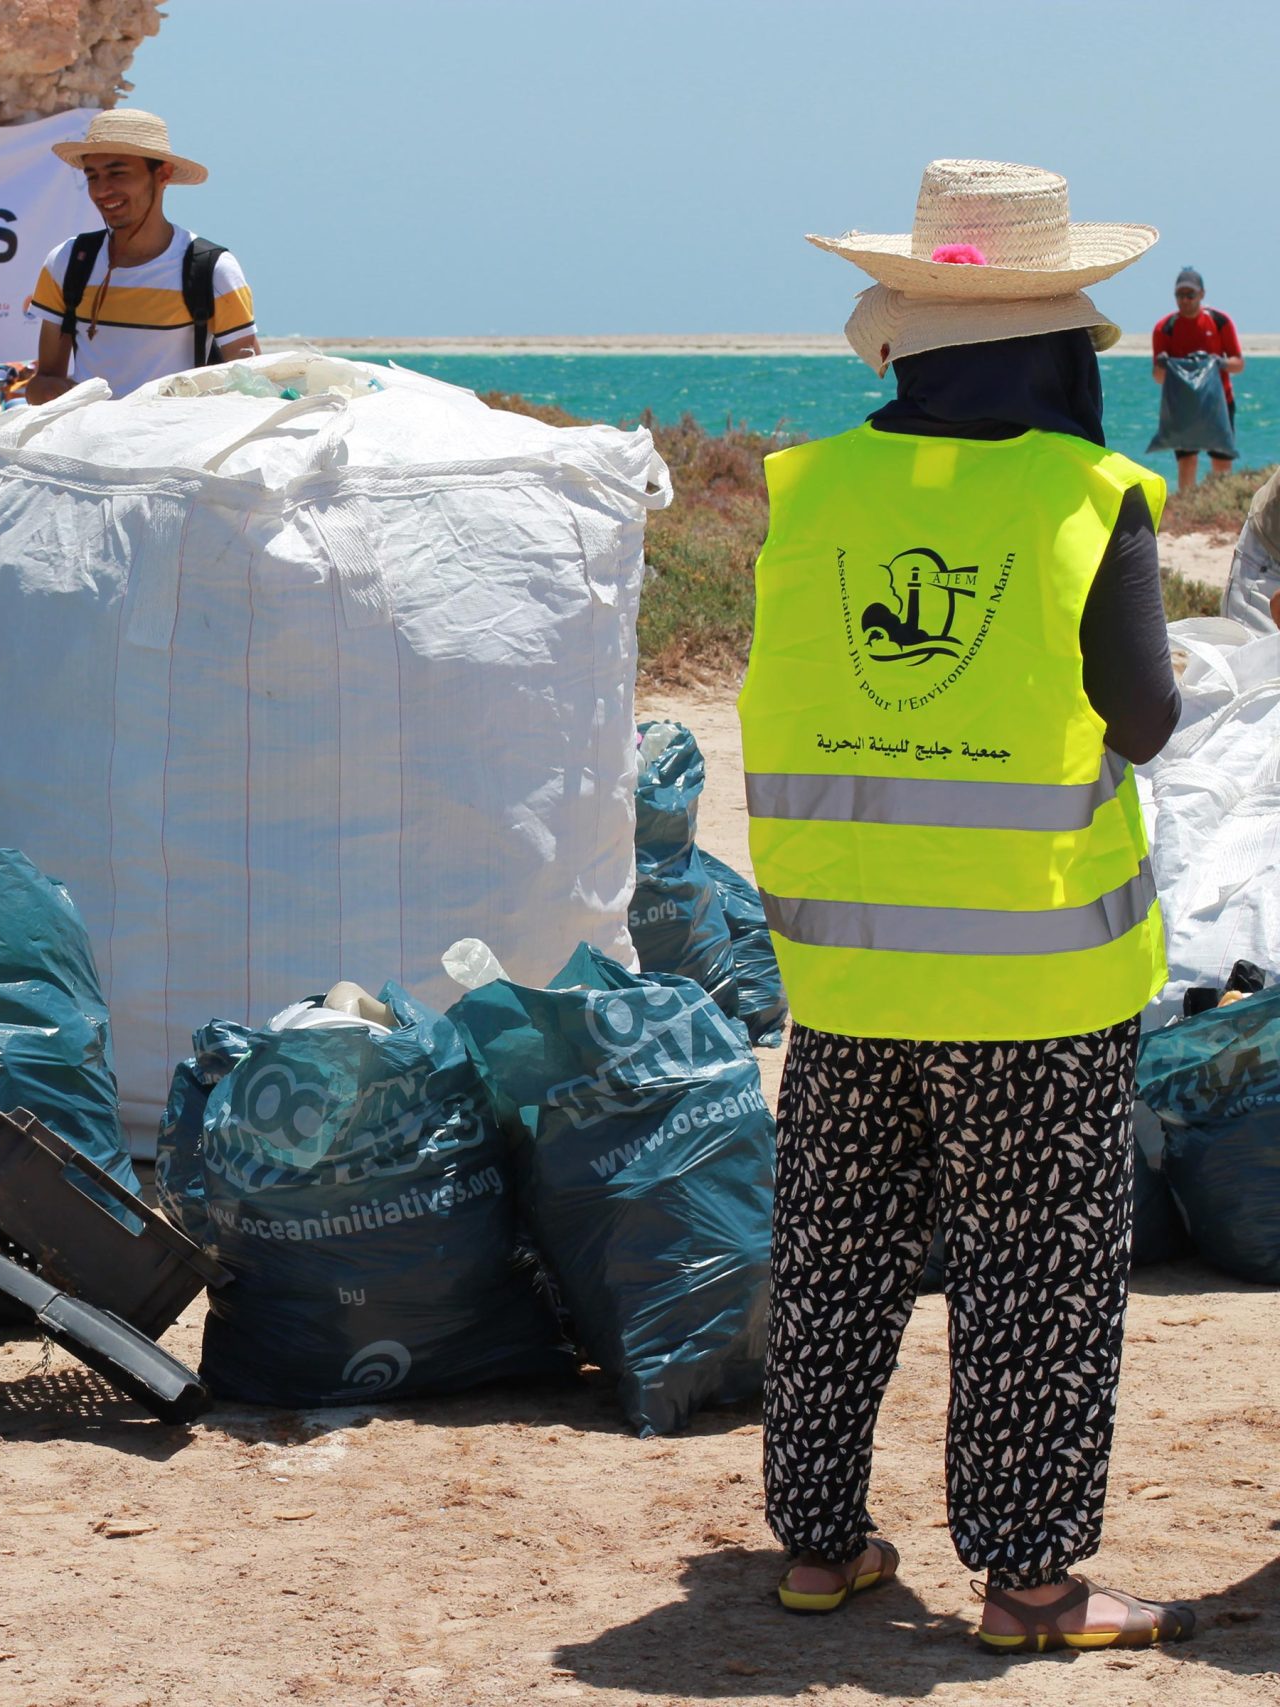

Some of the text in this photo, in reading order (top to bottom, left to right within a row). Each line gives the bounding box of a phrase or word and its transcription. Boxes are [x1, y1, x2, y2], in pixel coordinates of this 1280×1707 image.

[932, 573, 977, 587] AJEM
[837, 547, 854, 646] Association
[859, 680, 892, 711] pour
[990, 551, 1016, 603] Marin
[816, 733, 865, 756] البحرية
[869, 735, 910, 758] للبيئة
[961, 741, 1011, 763] جمعية
[338, 1287, 366, 1306] by
